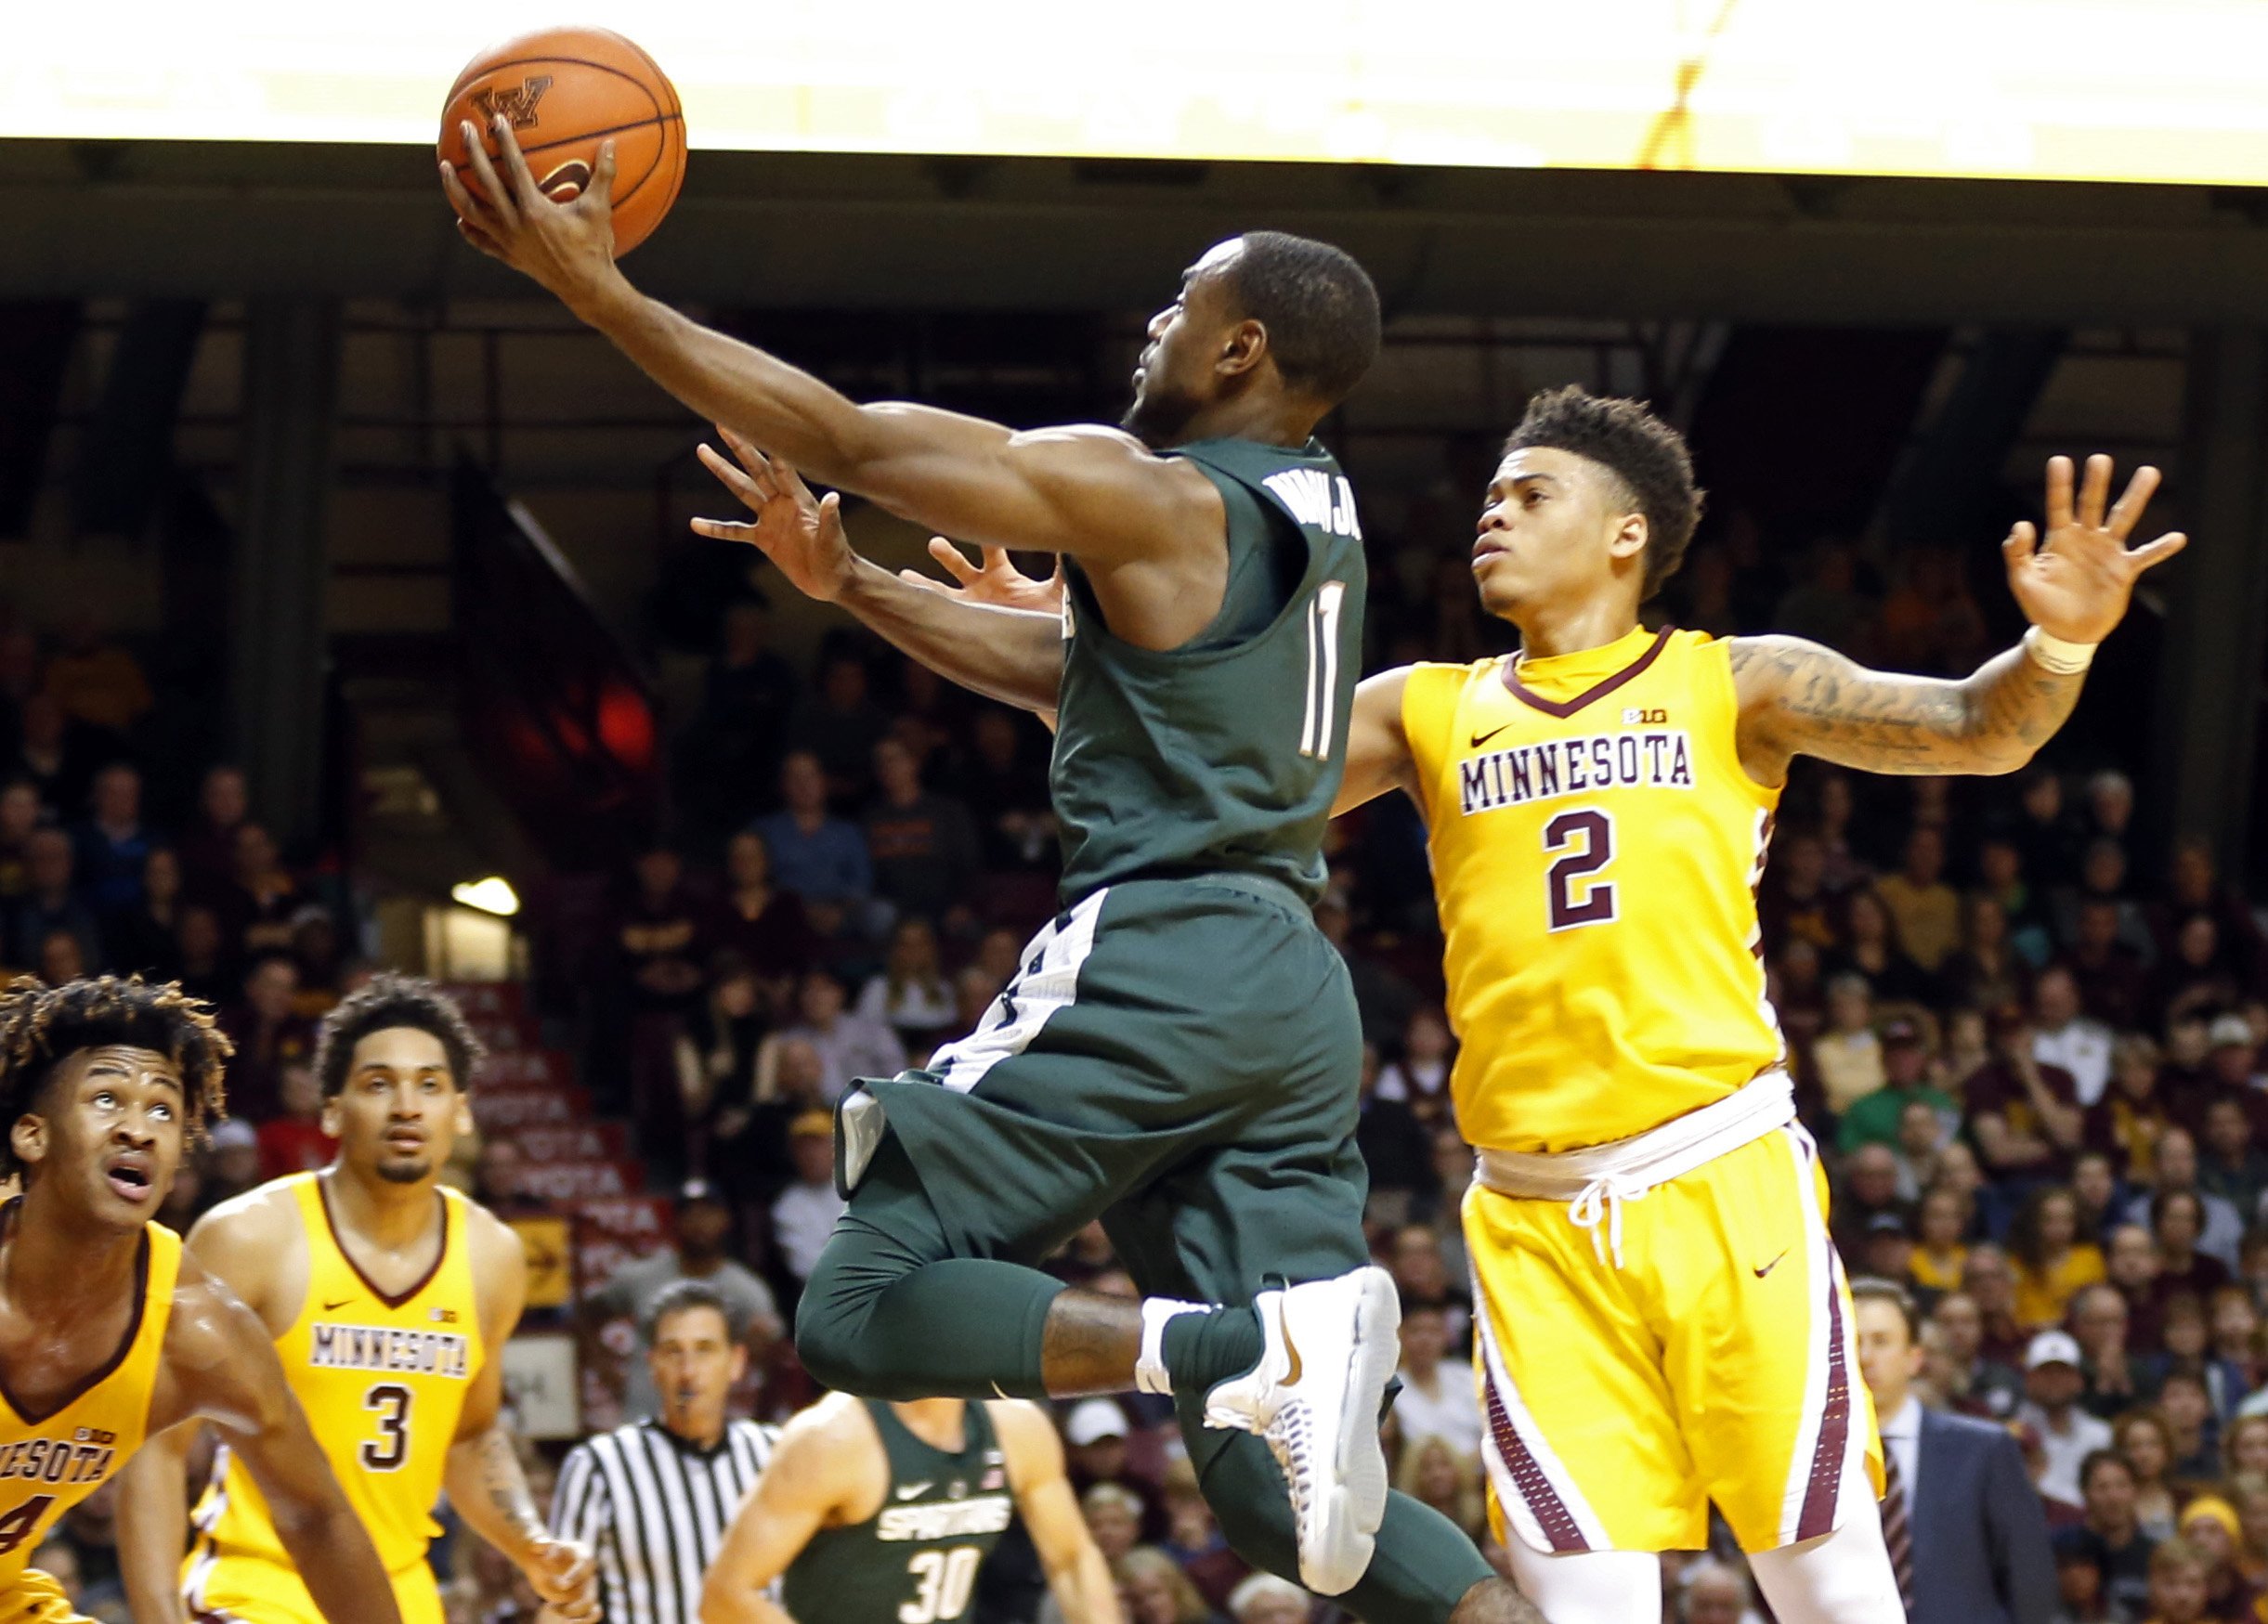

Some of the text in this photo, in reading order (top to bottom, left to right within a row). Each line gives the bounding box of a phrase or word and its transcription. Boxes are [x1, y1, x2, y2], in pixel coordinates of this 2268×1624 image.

[1298, 578, 1347, 761] 11
[1459, 730, 1695, 816] MINNESOTA
[1542, 805, 1620, 933] 2
[0, 1437, 116, 1485] ESOTA
[357, 1381, 412, 1473] 3
[897, 1547, 982, 1624] 30
